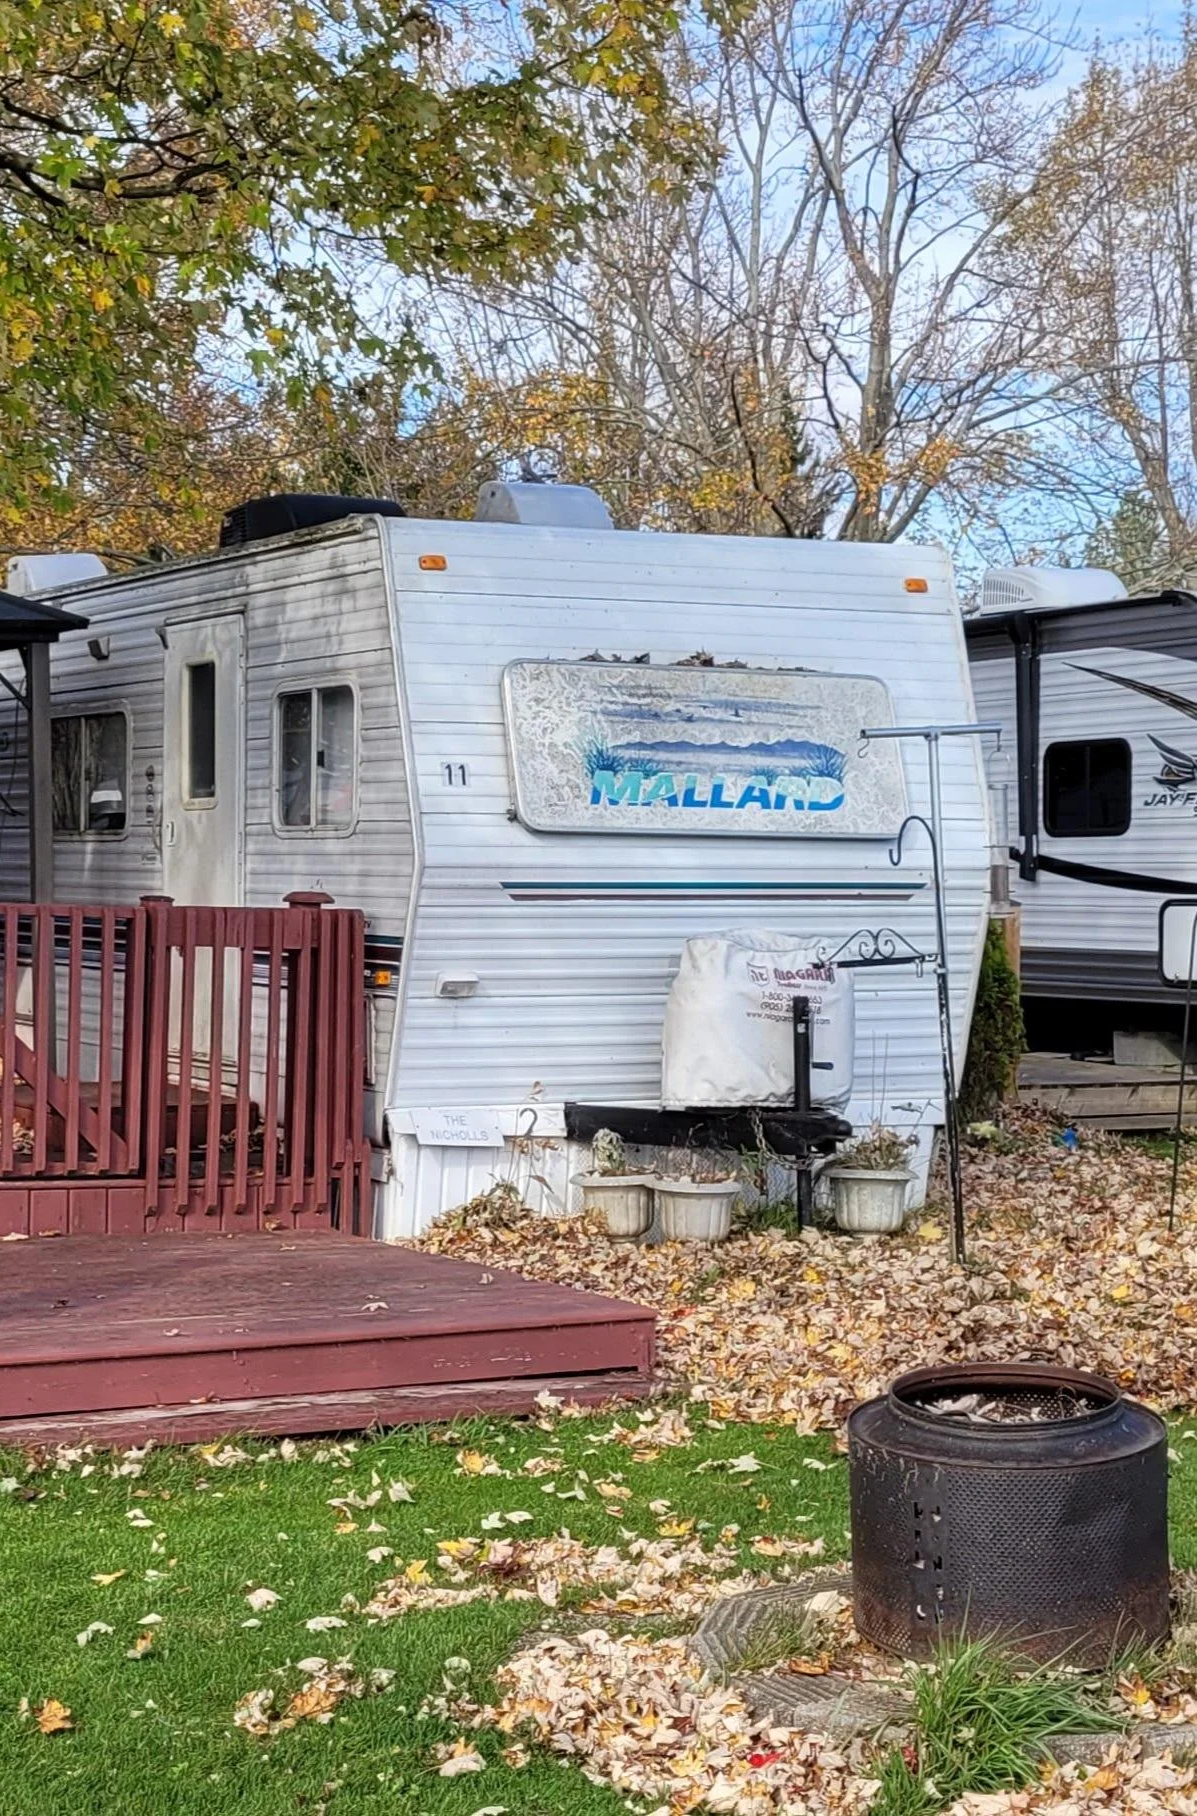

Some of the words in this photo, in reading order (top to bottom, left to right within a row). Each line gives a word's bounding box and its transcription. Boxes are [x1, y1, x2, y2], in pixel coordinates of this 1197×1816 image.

[445, 764, 466, 786] 11
[591, 771, 845, 811] MALLARD
[443, 1115, 468, 1126] THE
